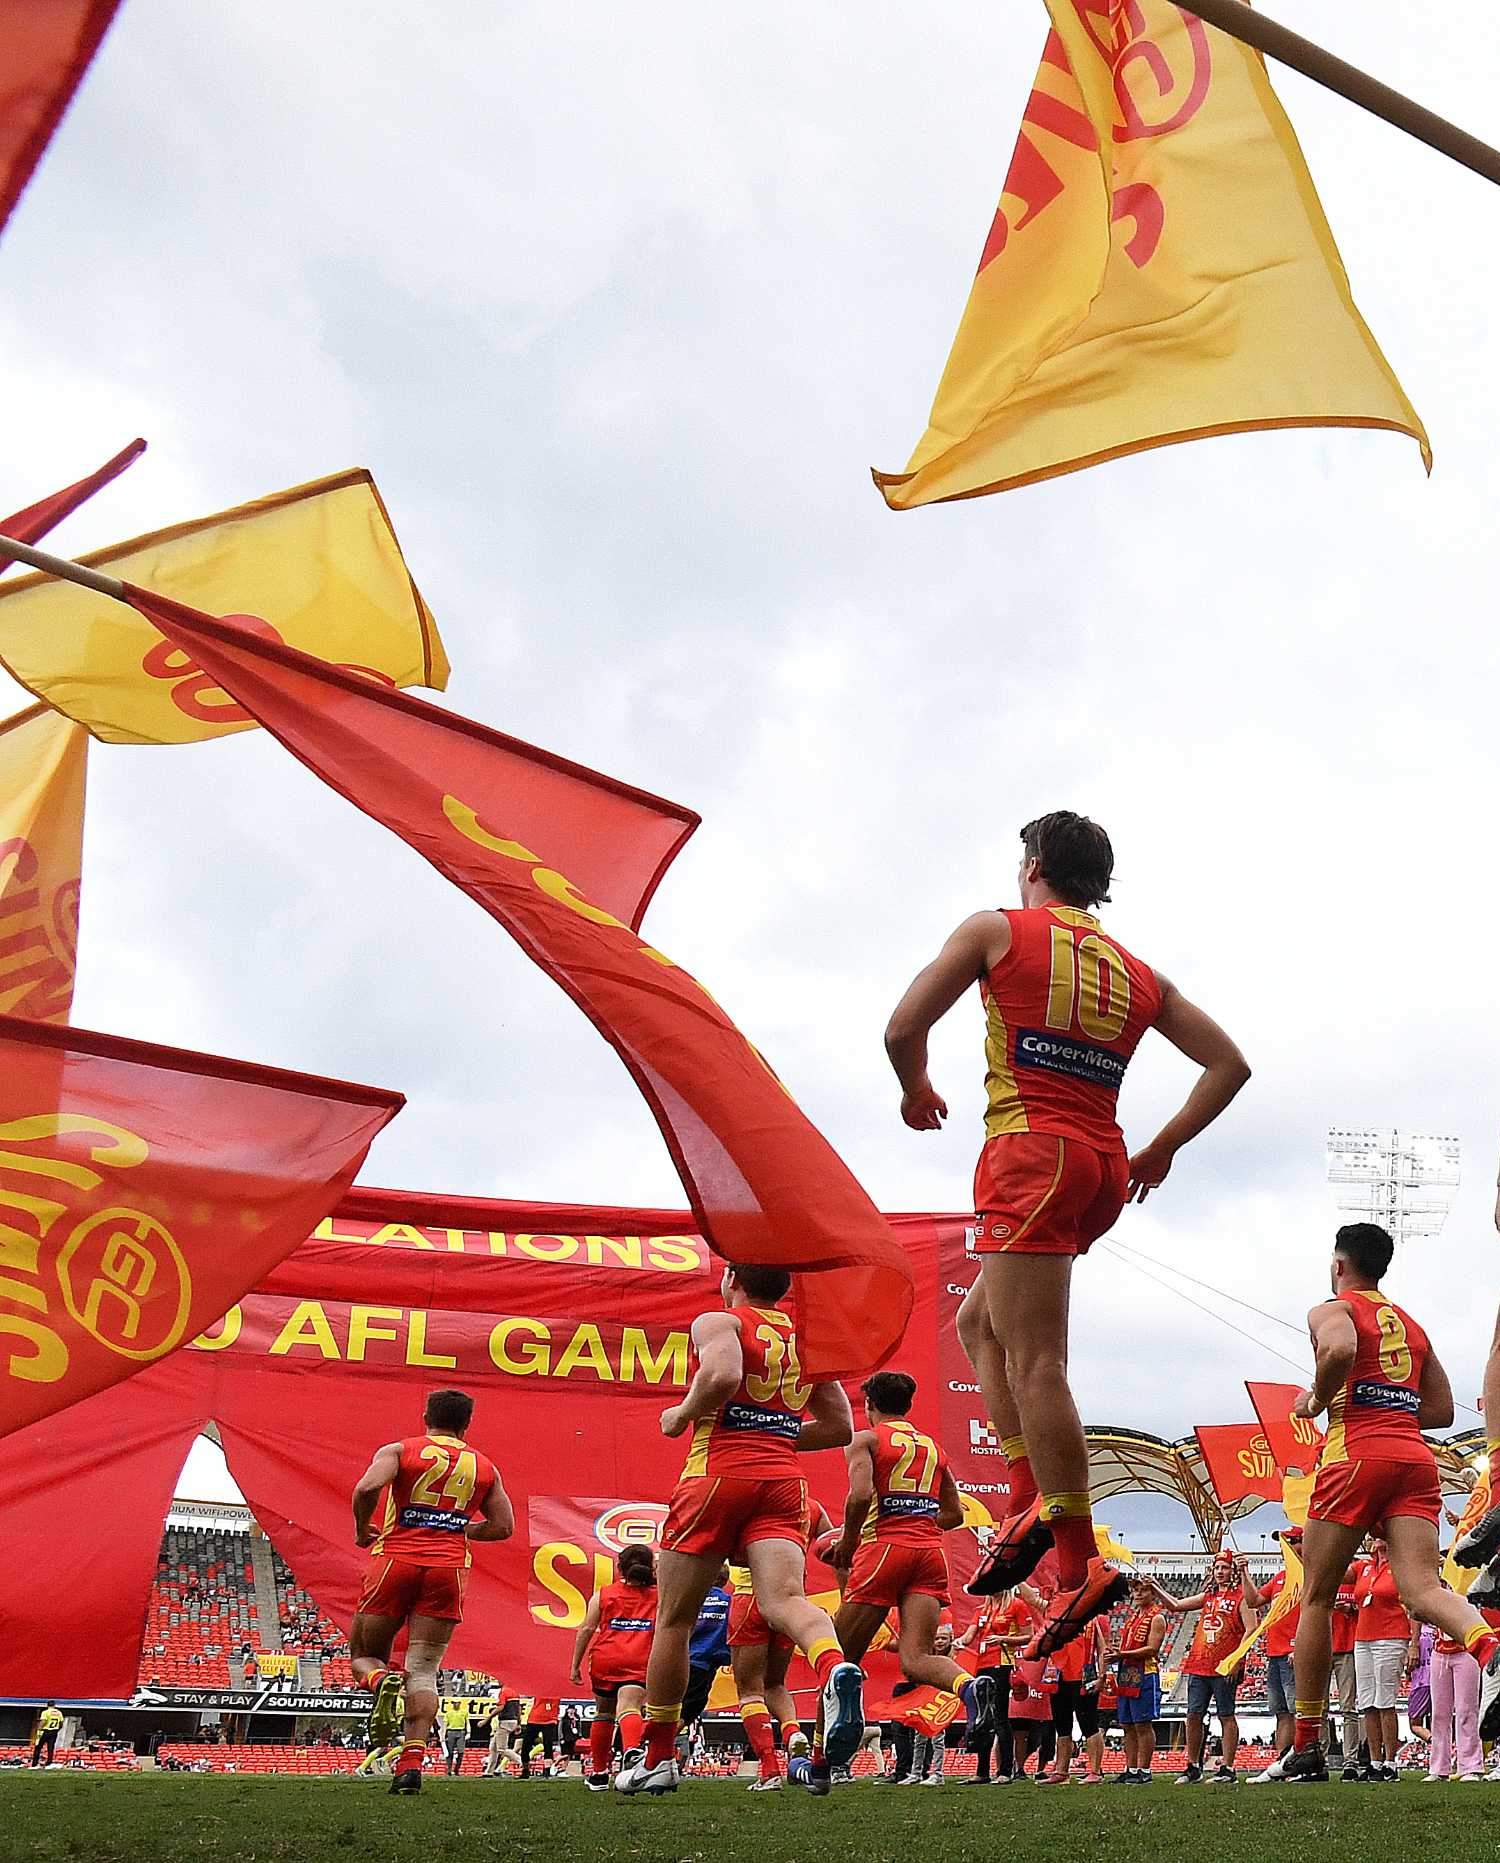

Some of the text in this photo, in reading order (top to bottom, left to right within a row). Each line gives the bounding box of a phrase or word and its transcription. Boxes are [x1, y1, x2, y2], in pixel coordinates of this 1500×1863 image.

[1045, 925, 1131, 1041] 10
[314, 1216, 701, 1272] LATIONS
[269, 1300, 457, 1369] AFL
[489, 1317, 690, 1386] GAM
[1376, 1305, 1412, 1382] 8
[409, 1444, 477, 1511] 24
[888, 1431, 938, 1493] 27
[174, 1693, 207, 1704] STAY
[208, 1694, 218, 1705] &
[220, 1696, 253, 1705] PLAY
[268, 1697, 350, 1708] SOUTHPORT
